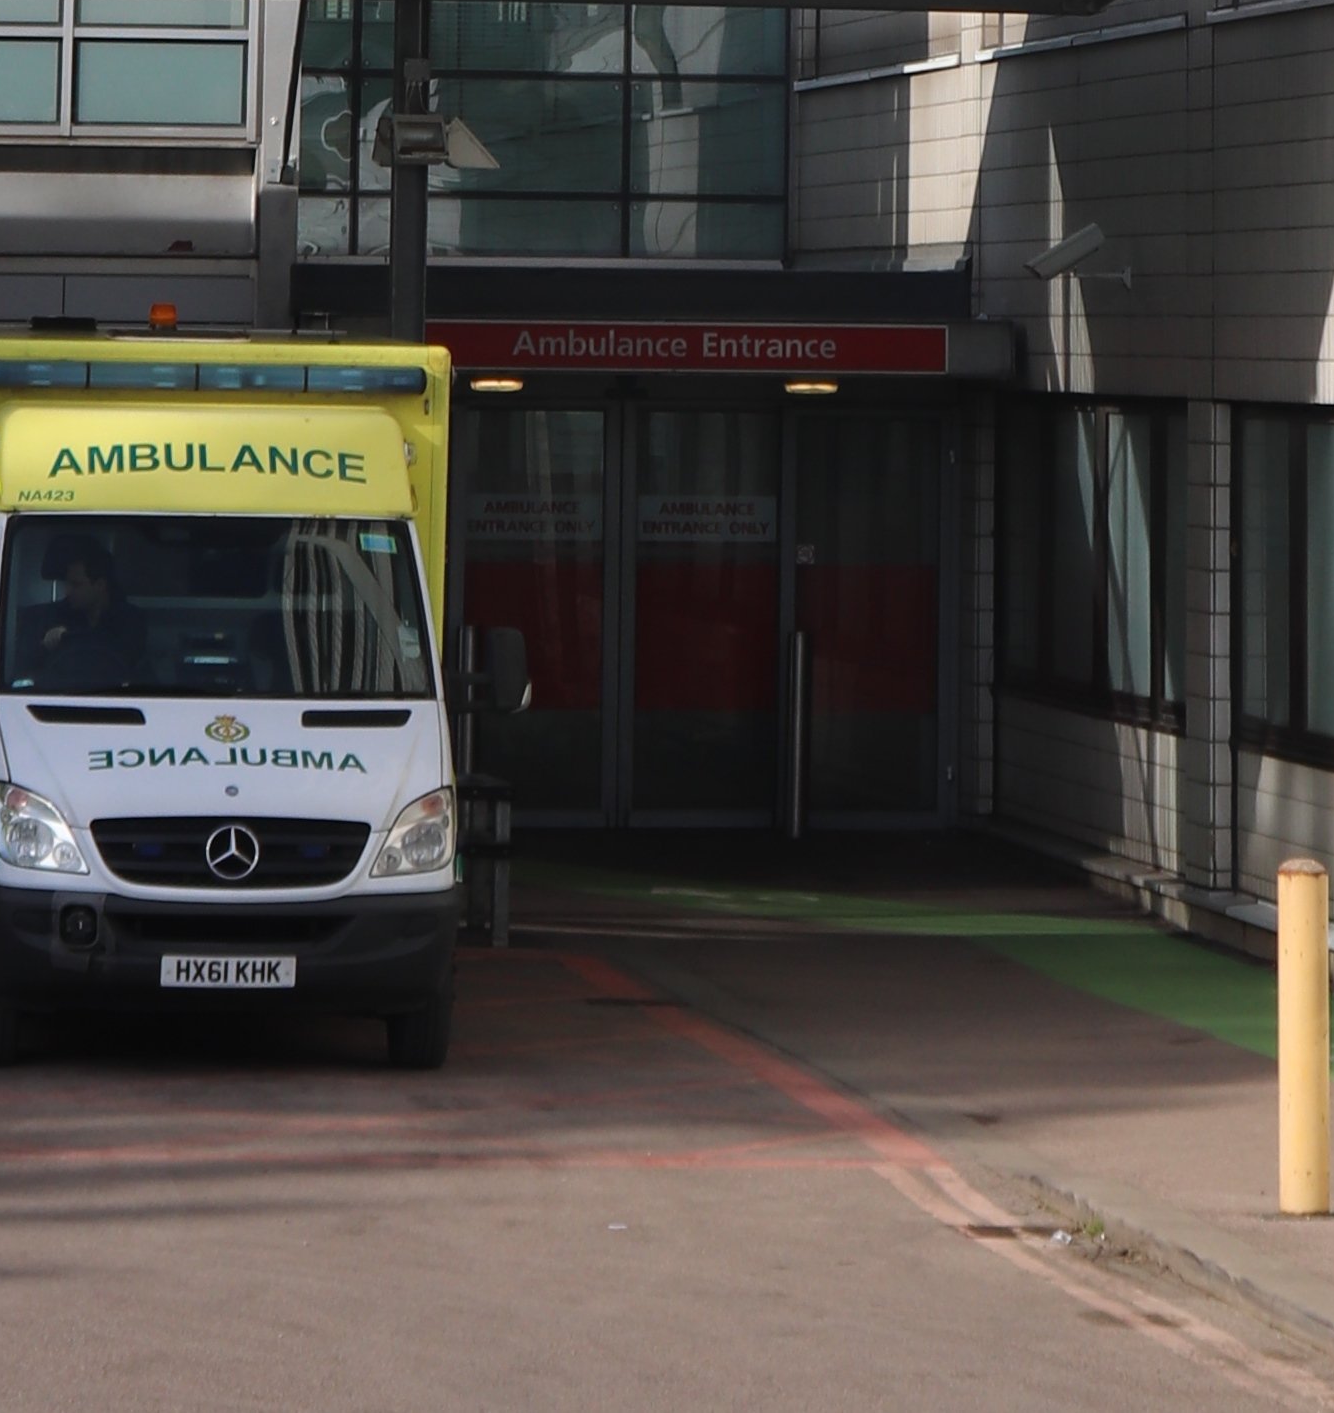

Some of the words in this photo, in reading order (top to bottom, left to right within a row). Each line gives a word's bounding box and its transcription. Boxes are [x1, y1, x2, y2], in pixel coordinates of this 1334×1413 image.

[513, 330, 688, 359] Ambulance
[701, 332, 838, 360] Entrance
[49, 444, 366, 484] AMBULANCE
[18, 490, 74, 502] NA423
[483, 500, 581, 515] AMBULANCE
[659, 501, 756, 517] AMBULANCE
[467, 520, 547, 534] ENTRANCE
[642, 520, 722, 535] ENTRANCE
[729, 520, 771, 536] ONLY
[175, 960, 230, 984] HX61
[236, 961, 282, 983] KHK
